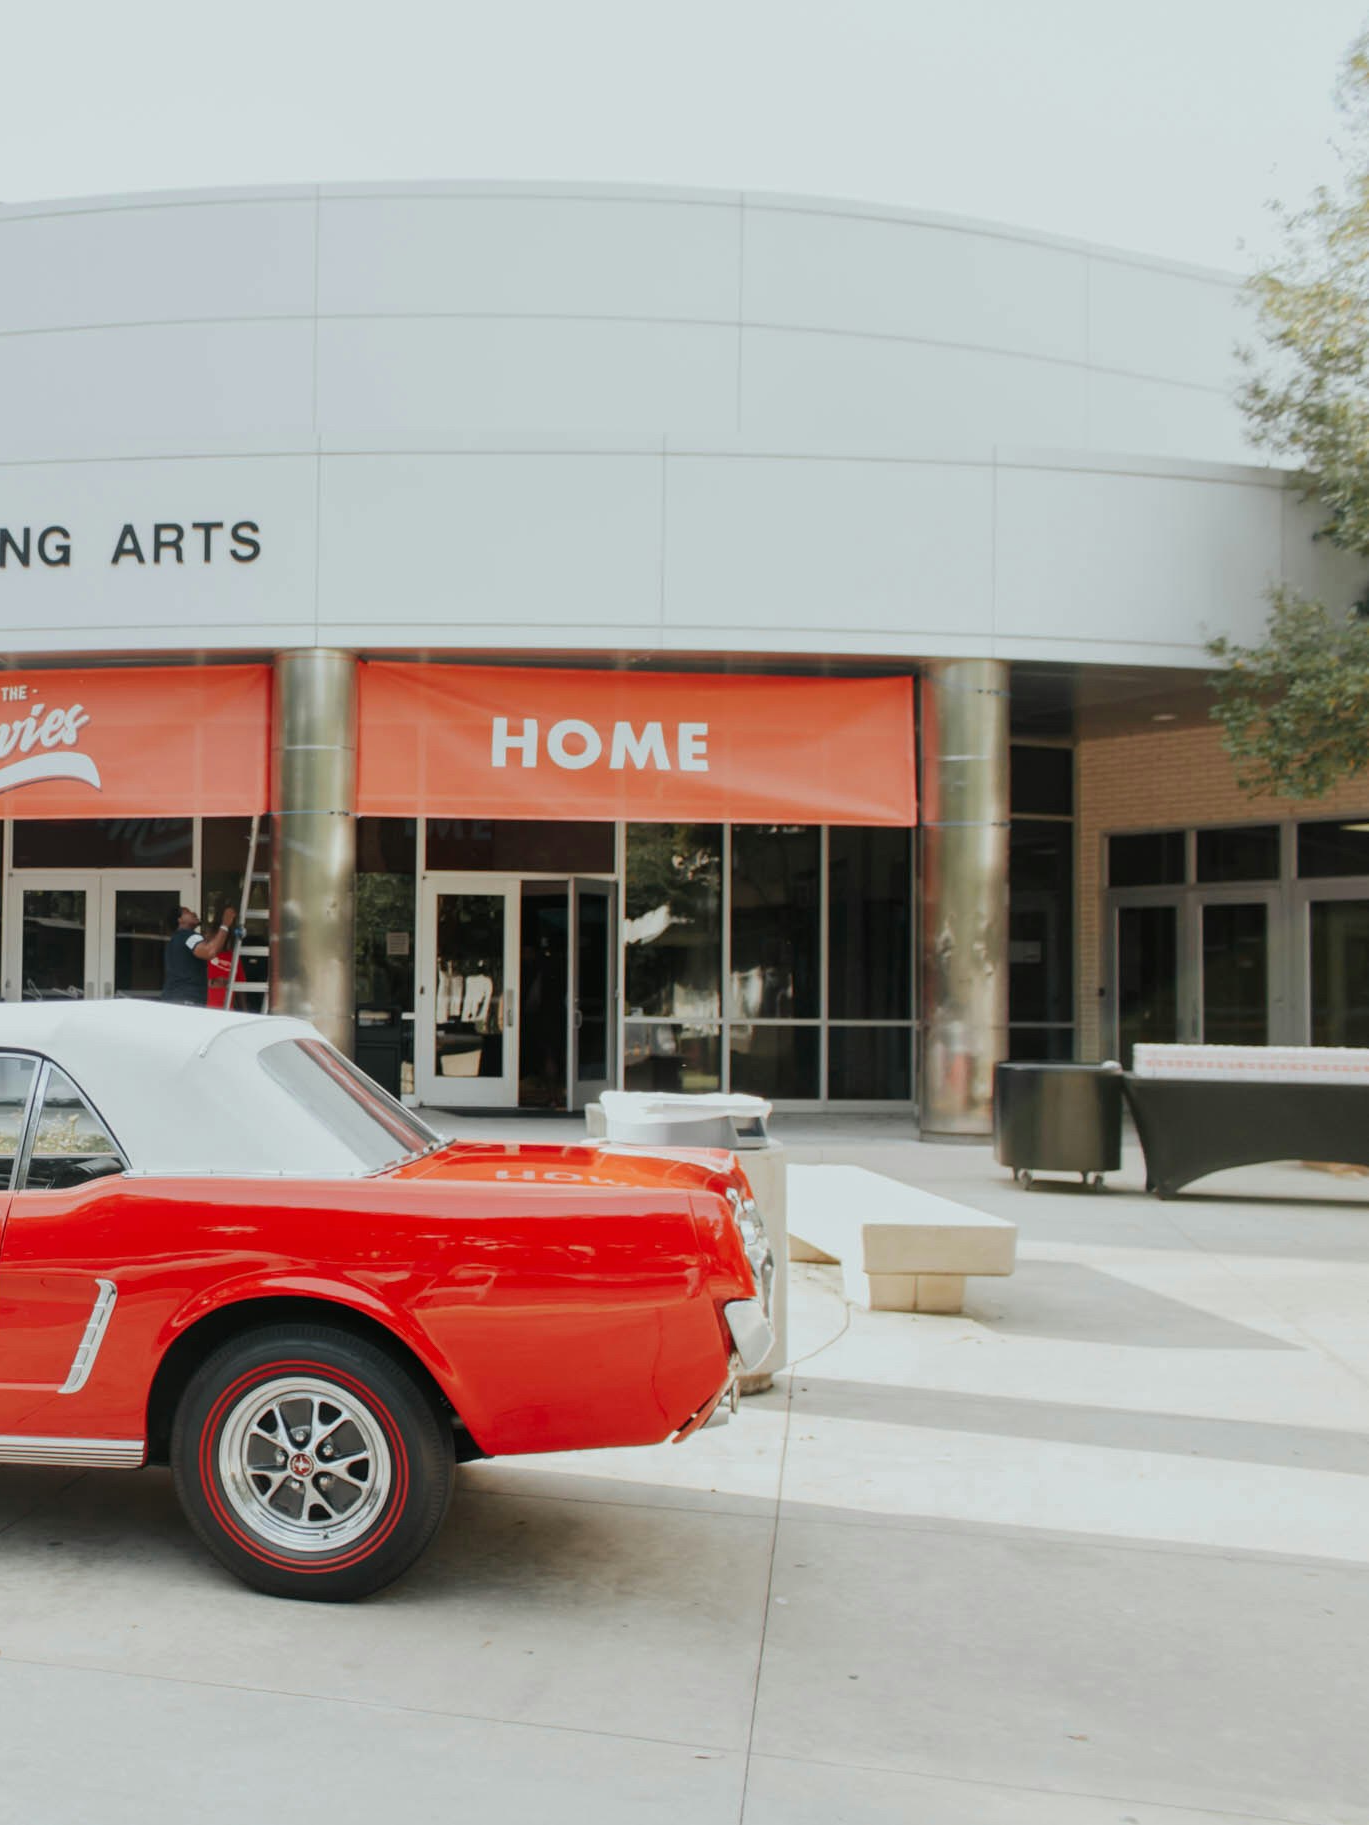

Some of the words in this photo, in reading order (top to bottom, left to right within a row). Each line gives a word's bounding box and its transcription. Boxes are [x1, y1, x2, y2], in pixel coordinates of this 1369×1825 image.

[110, 520, 262, 565] ARTS
[1, 685, 27, 702] THE
[491, 717, 710, 772] HOME
